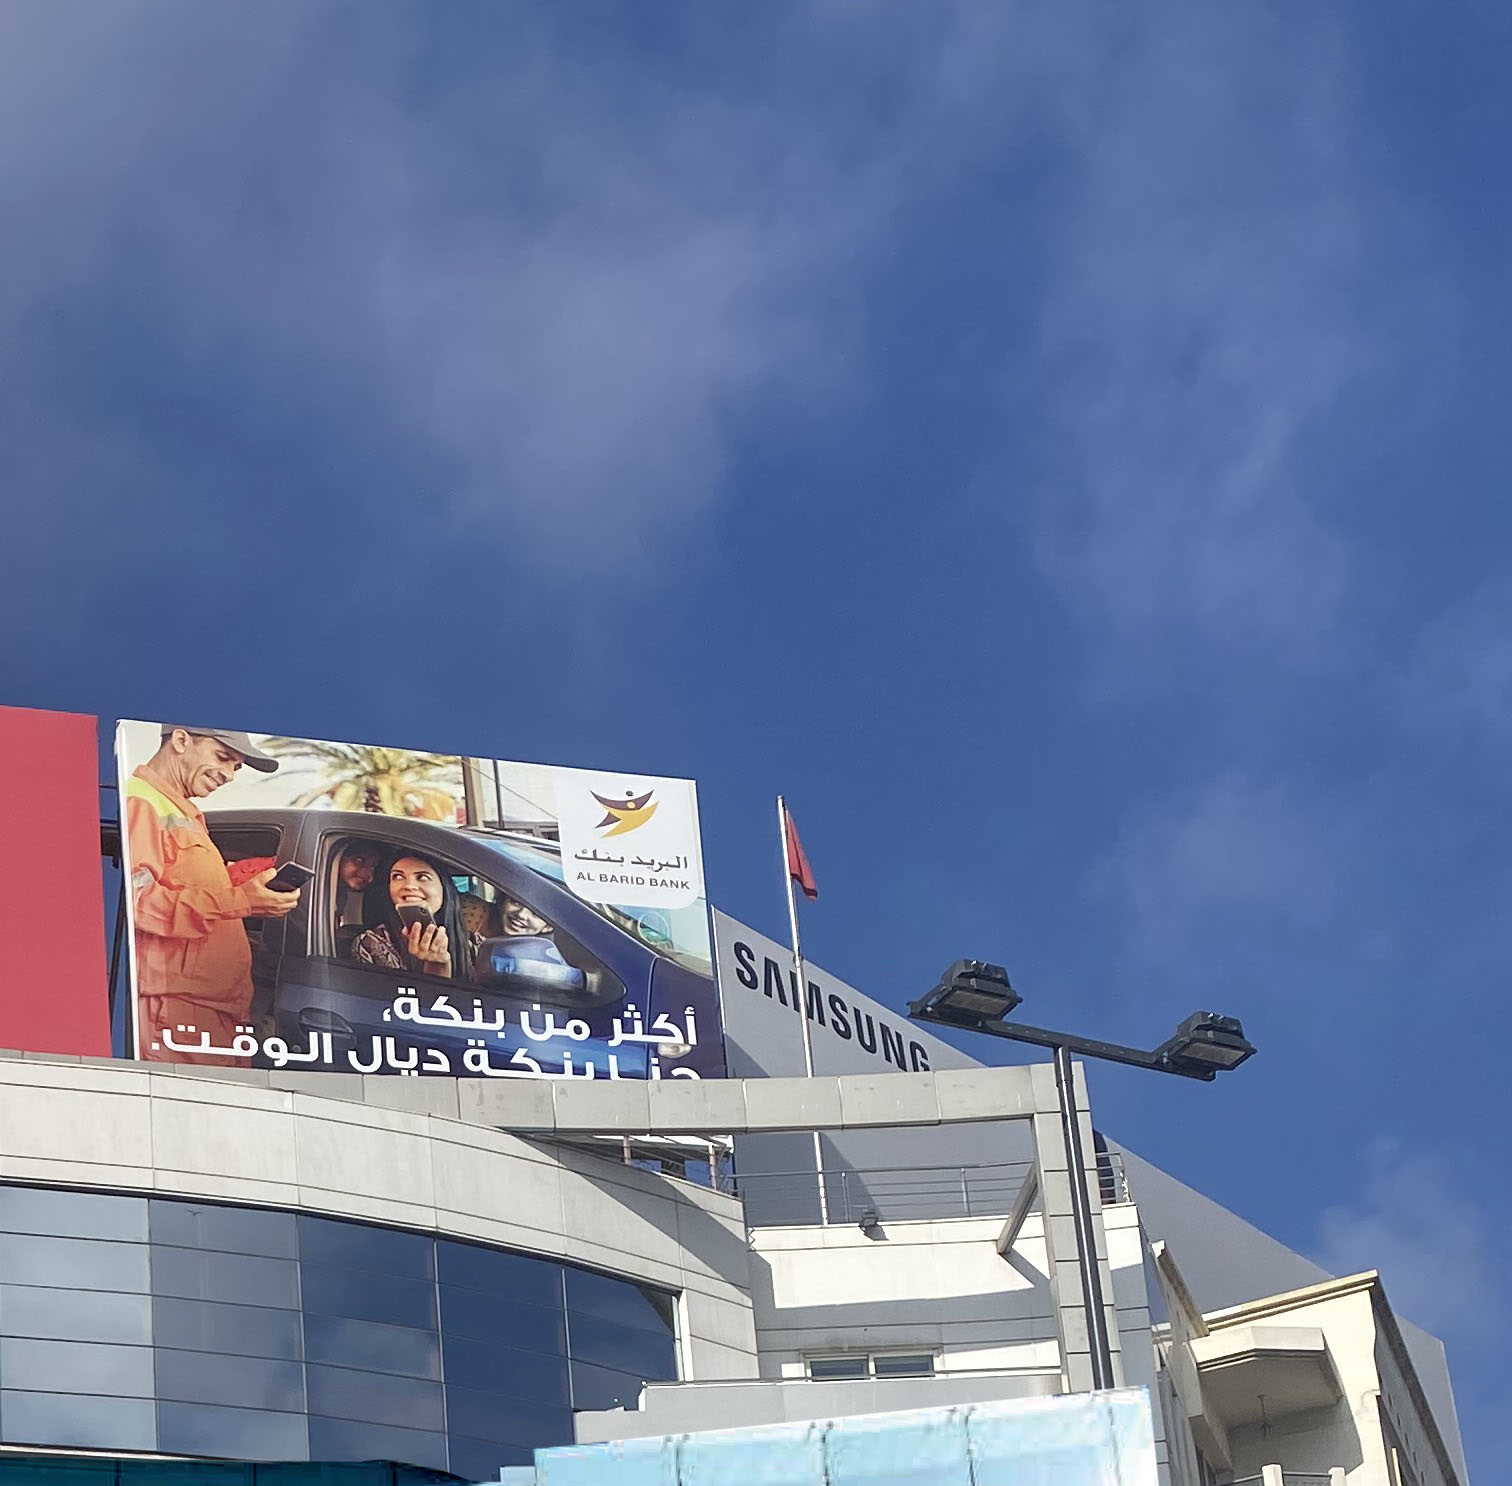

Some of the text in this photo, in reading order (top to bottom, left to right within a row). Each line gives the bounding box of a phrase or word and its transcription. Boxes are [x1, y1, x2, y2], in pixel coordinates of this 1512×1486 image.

[577, 872, 690, 889] AL BARID BANK
[630, 856, 688, 872] البريد
[521, 1002, 591, 1042] من
[606, 1003, 698, 1046] أكثر
[733, 941, 930, 1072] SAMSUNG
[348, 1035, 451, 1077] ديال
